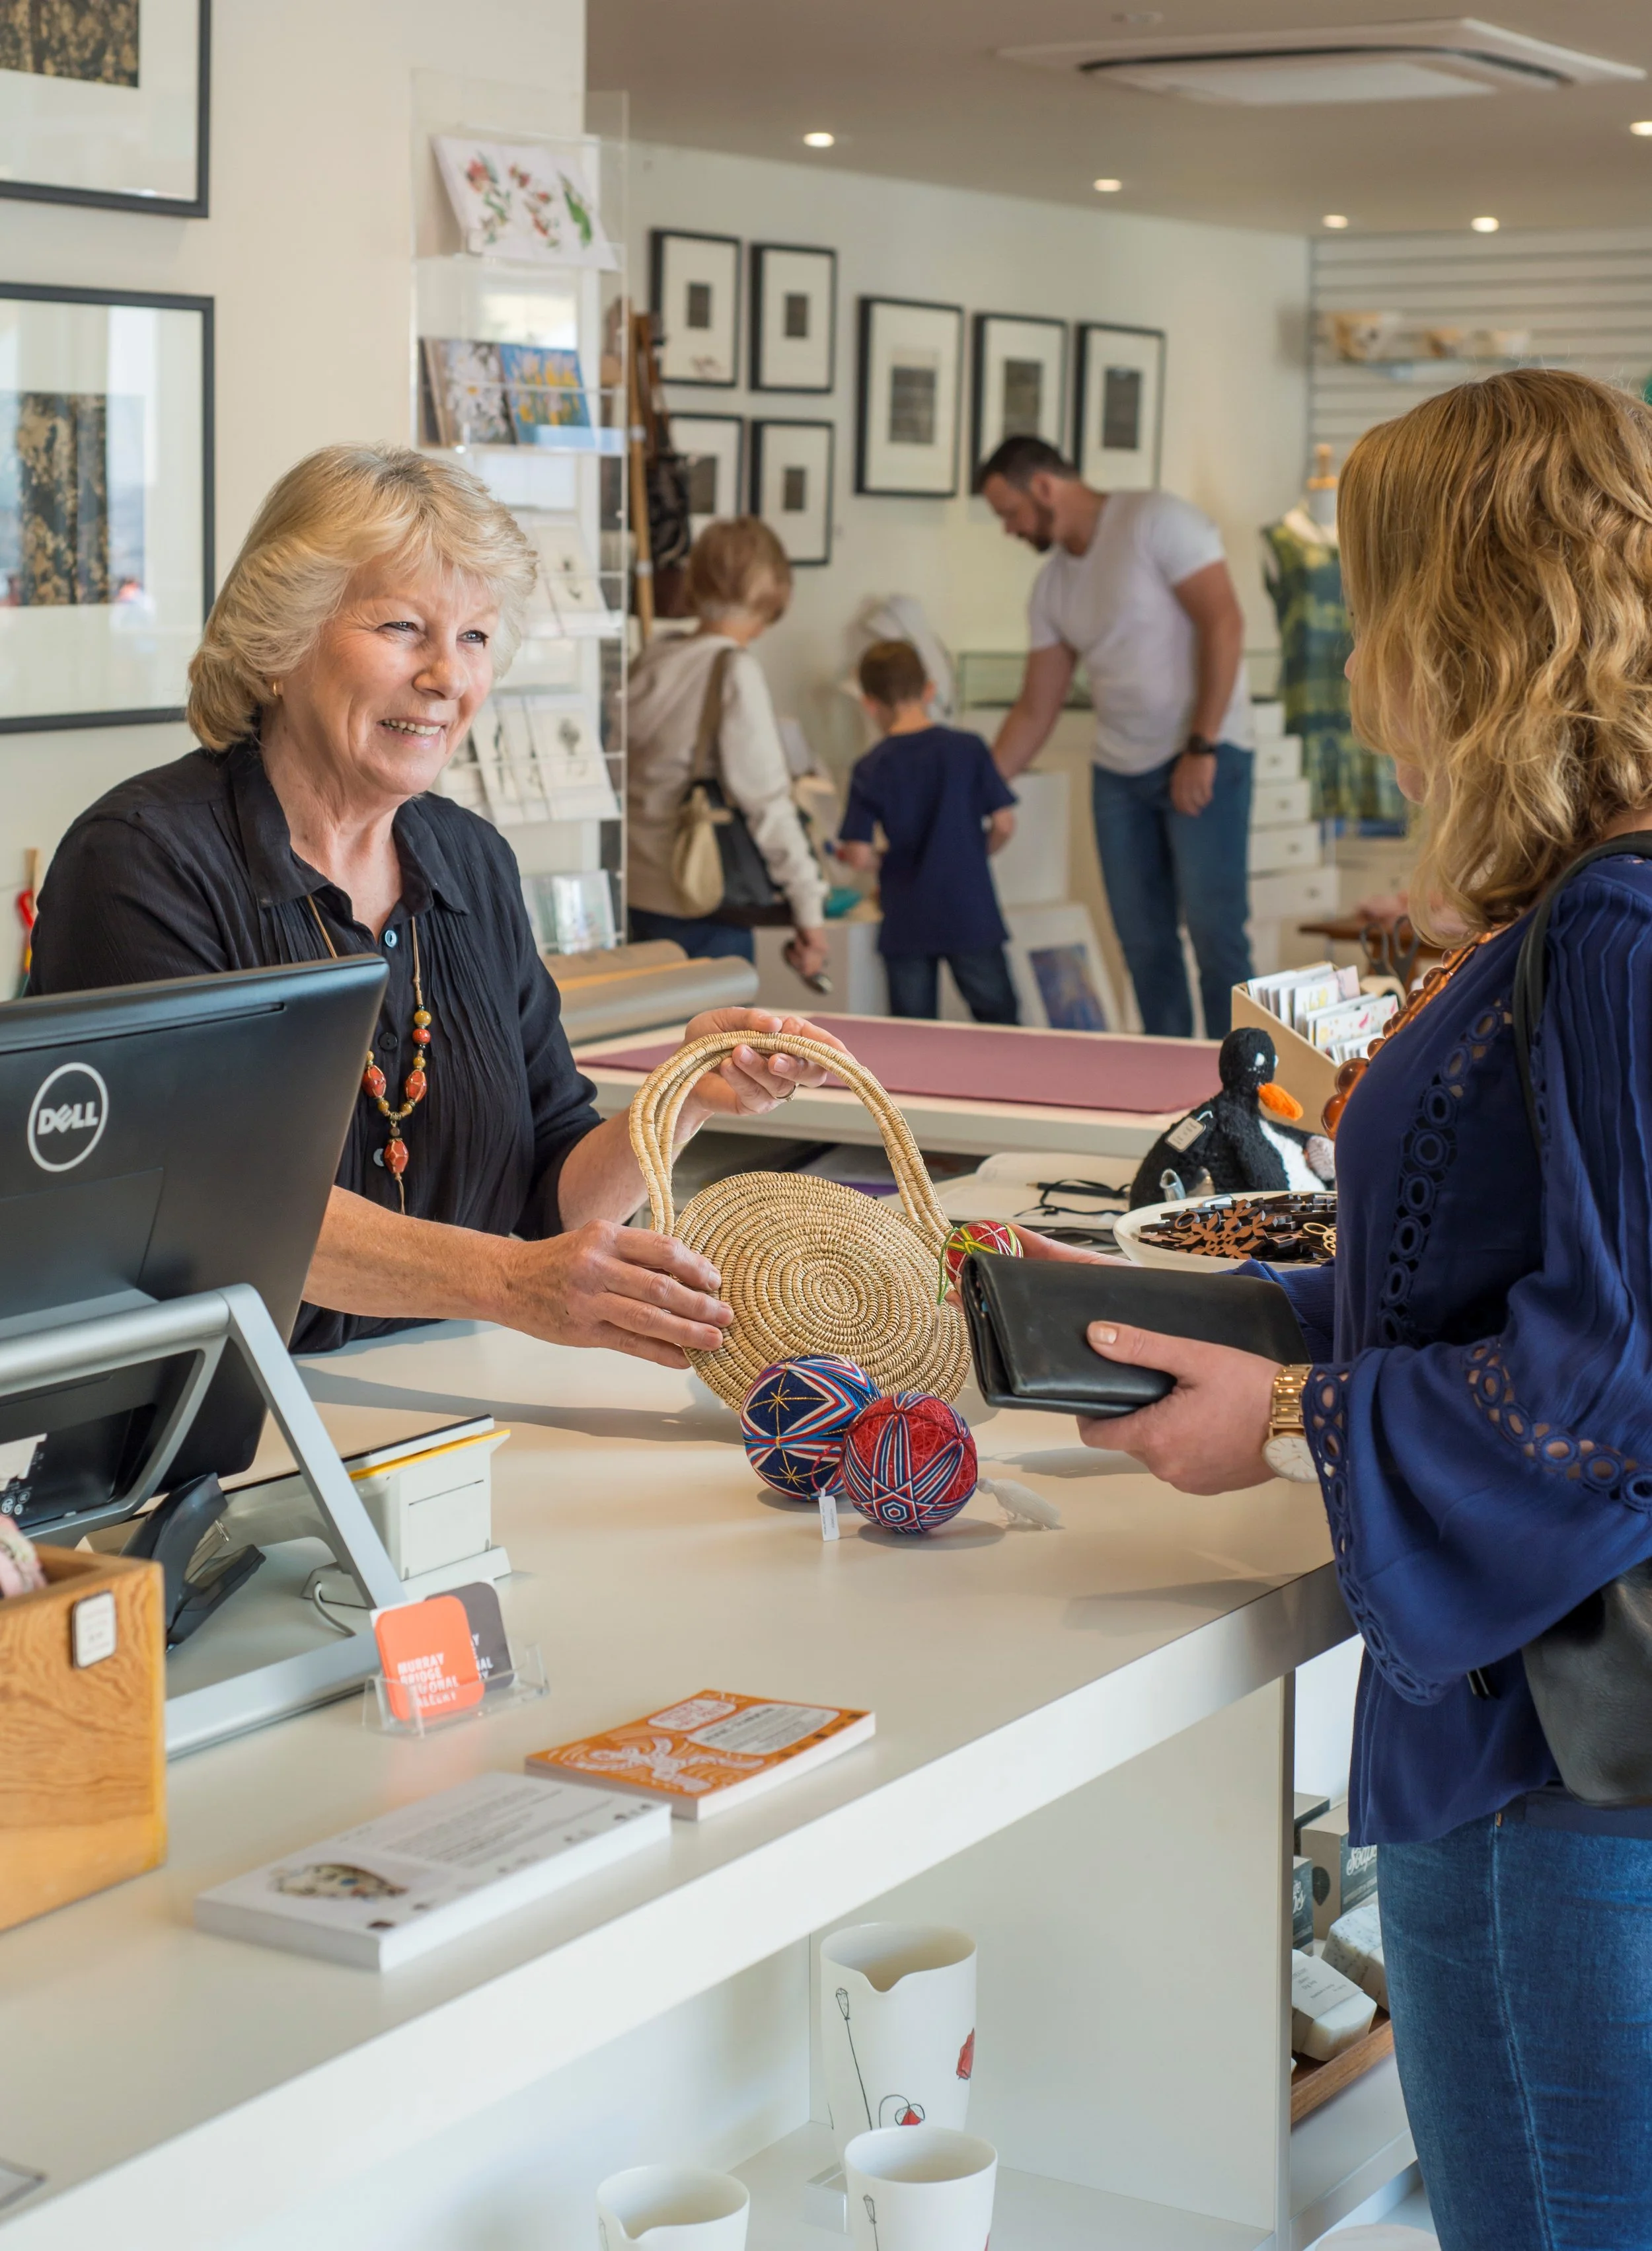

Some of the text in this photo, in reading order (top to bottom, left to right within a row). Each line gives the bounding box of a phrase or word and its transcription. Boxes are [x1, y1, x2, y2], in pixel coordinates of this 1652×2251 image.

[37, 1101, 98, 1135] DELL
[397, 1652, 444, 1676] MURRAY
[400, 1665, 443, 1686] BRIDGE
